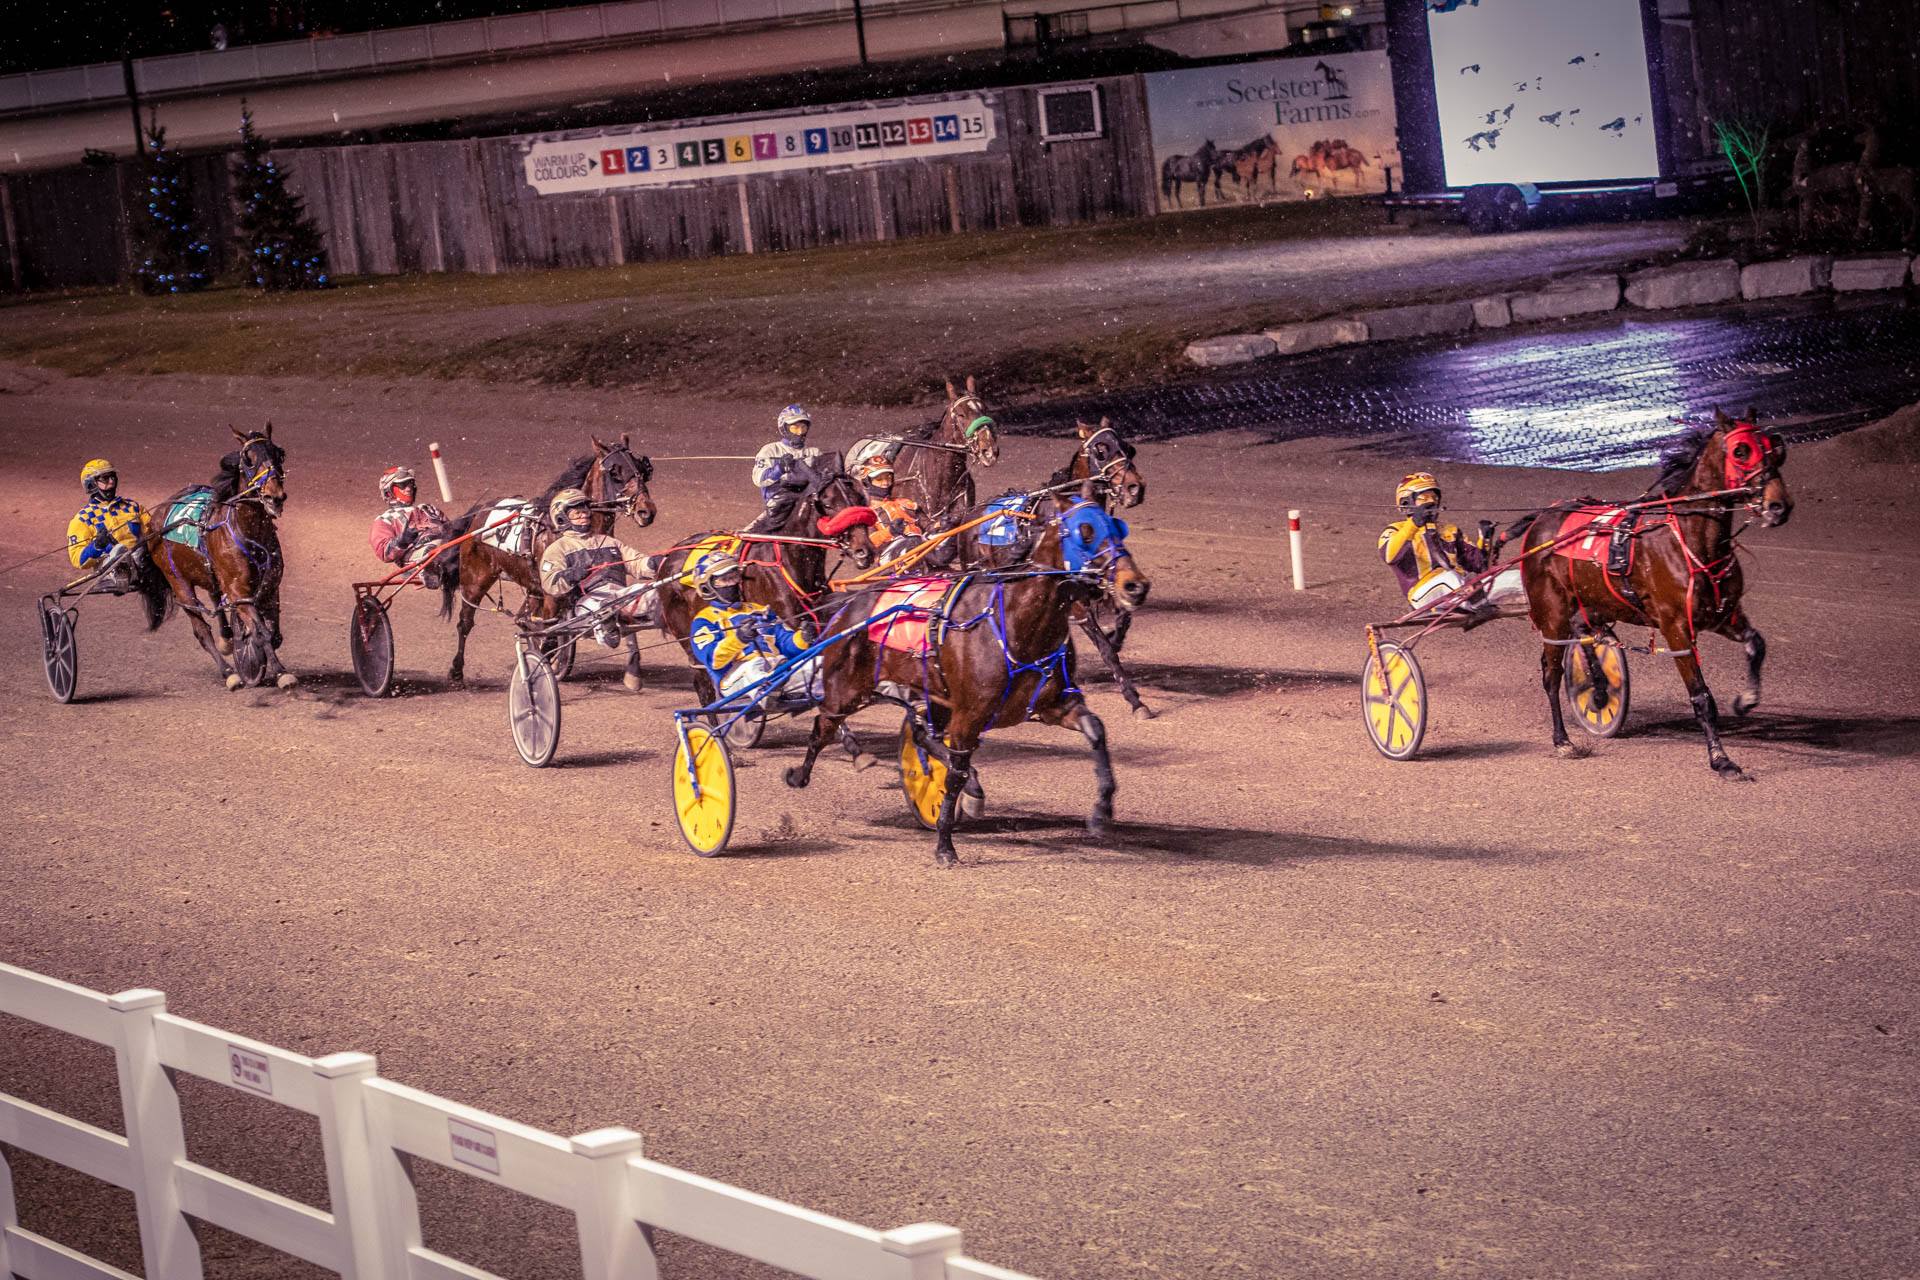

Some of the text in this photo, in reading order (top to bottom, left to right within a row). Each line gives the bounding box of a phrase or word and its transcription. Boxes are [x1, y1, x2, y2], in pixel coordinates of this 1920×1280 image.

[1273, 101, 1352, 125] Farms
[607, 117, 983, 170] 1 2 3 4 5 6 7 8 9 10 11 12 13 14 15
[533, 153, 585, 168] WARM UP
[535, 165, 588, 181] COLOURS
